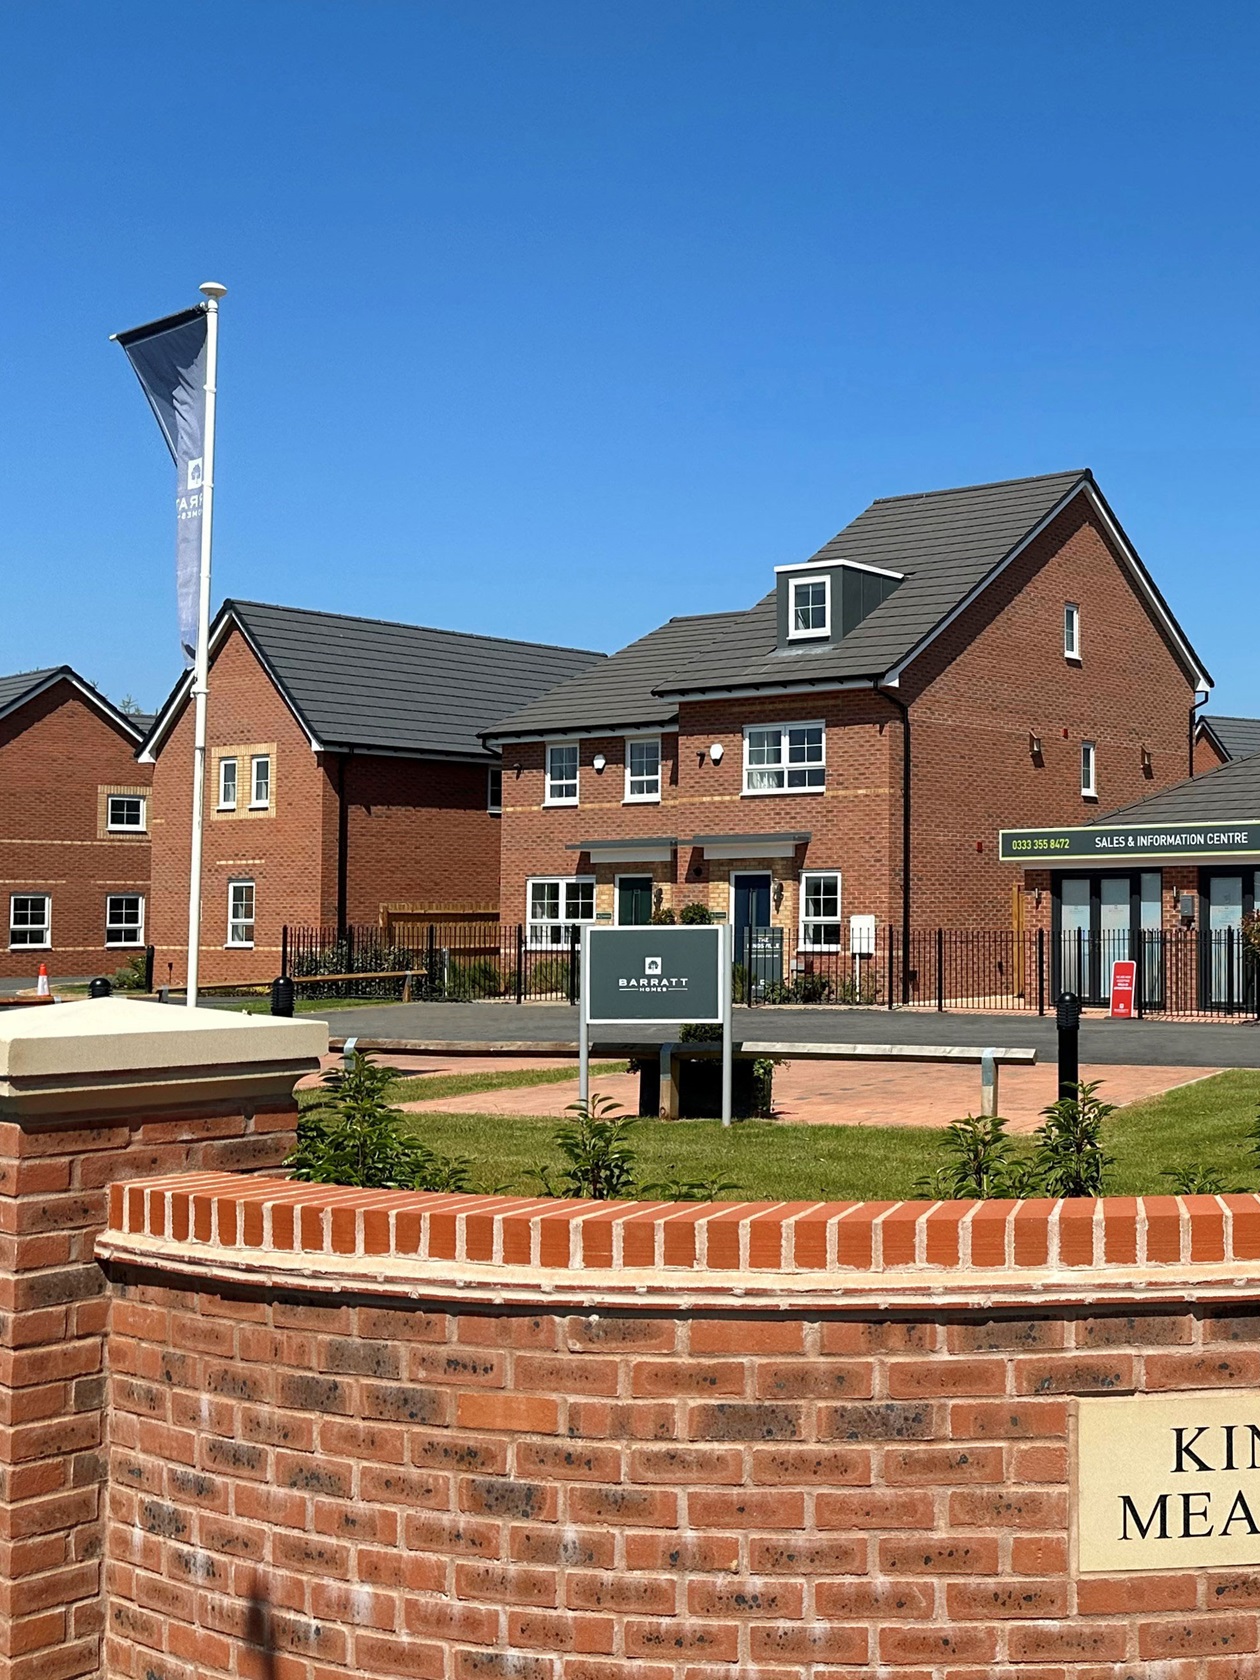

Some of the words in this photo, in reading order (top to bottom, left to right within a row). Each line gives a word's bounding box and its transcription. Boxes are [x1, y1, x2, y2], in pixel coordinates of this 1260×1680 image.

[1012, 840, 1031, 850] 0333
[1033, 839, 1048, 850] 355
[1049, 838, 1070, 849] 8472
[1095, 836, 1125, 848] SALES
[1127, 836, 1135, 847] &
[1137, 834, 1204, 847] INFORMATION
[1207, 832, 1249, 844] CENTRE
[618, 978, 689, 987] BARRATT
